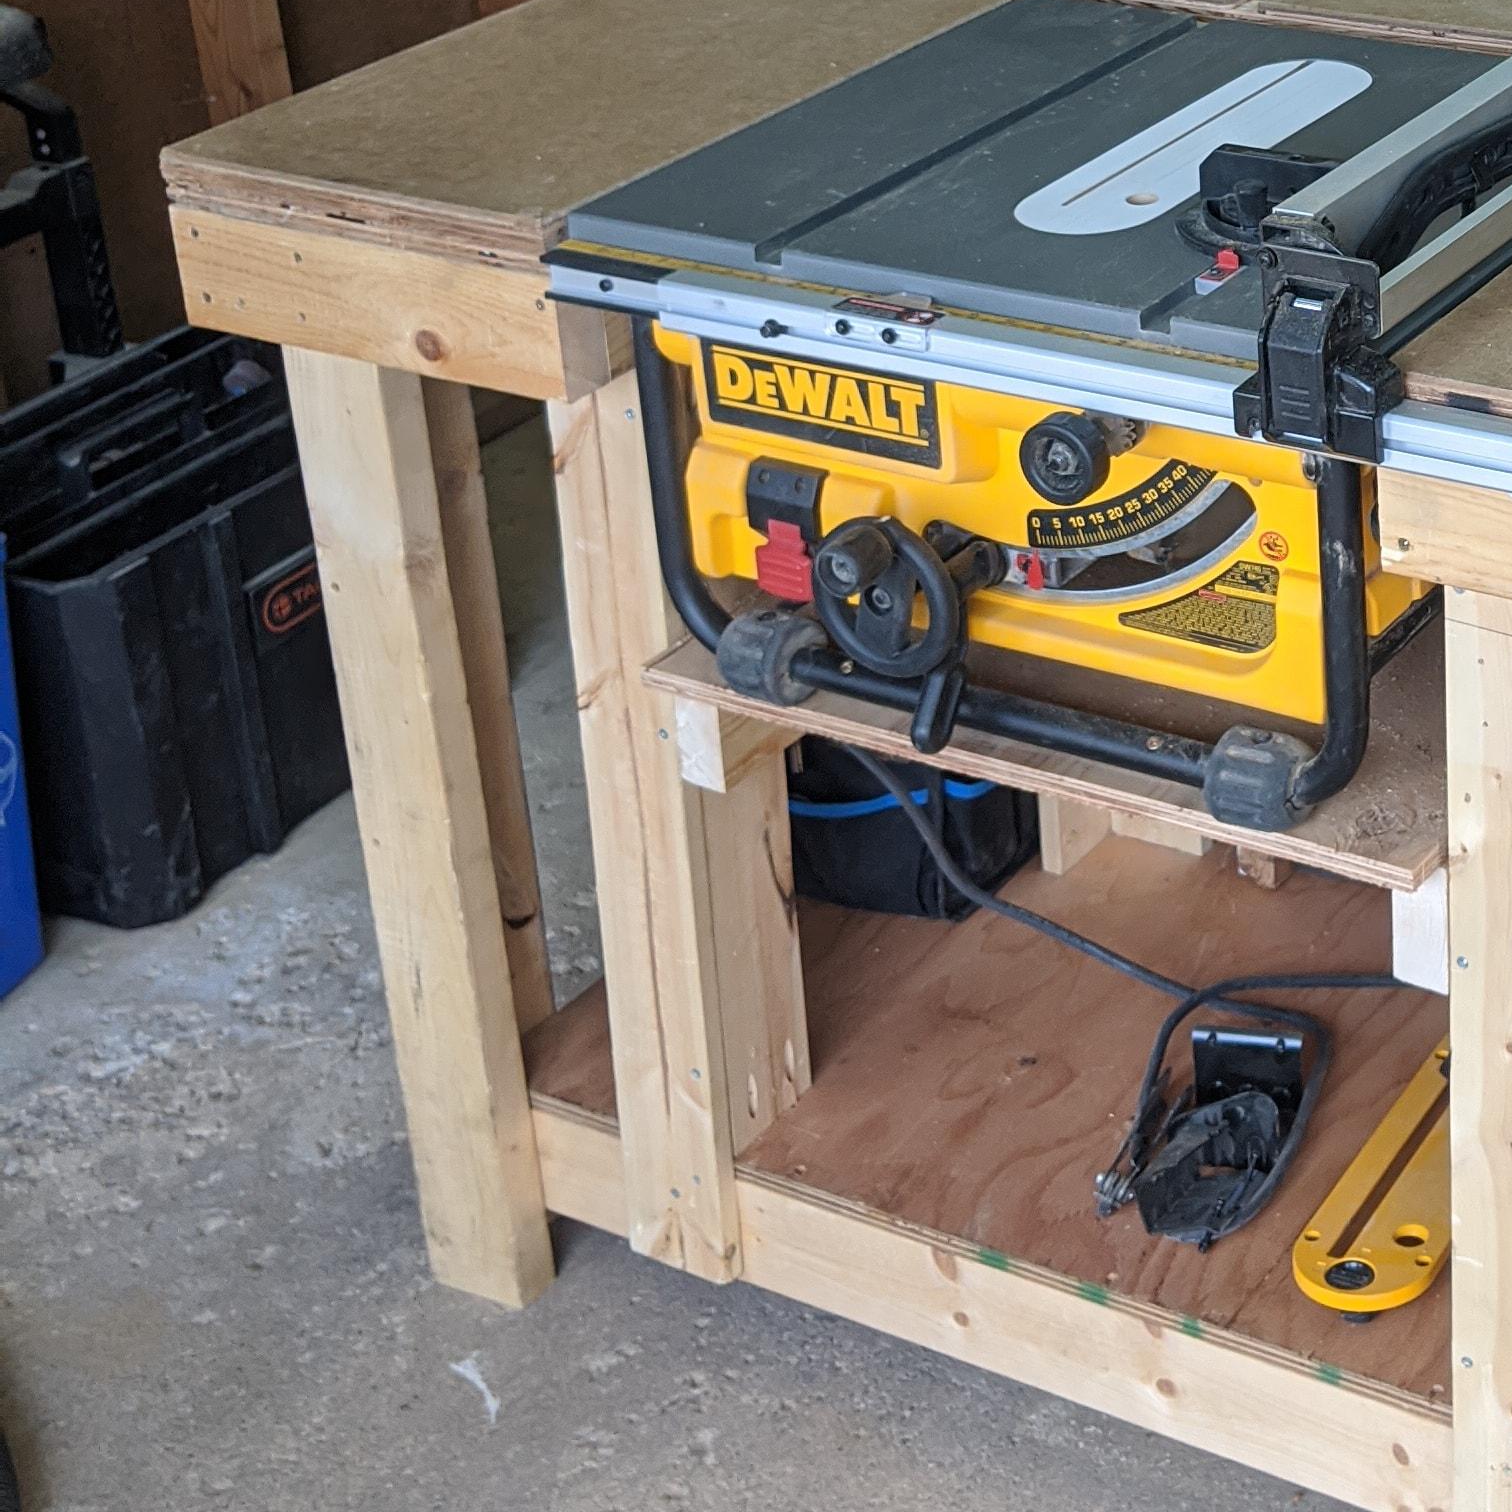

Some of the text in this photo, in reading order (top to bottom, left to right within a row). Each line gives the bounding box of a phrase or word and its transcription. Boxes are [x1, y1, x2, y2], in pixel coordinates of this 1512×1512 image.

[1031, 464, 1188, 529] 0 5 10 15 20 25 30 35 40
